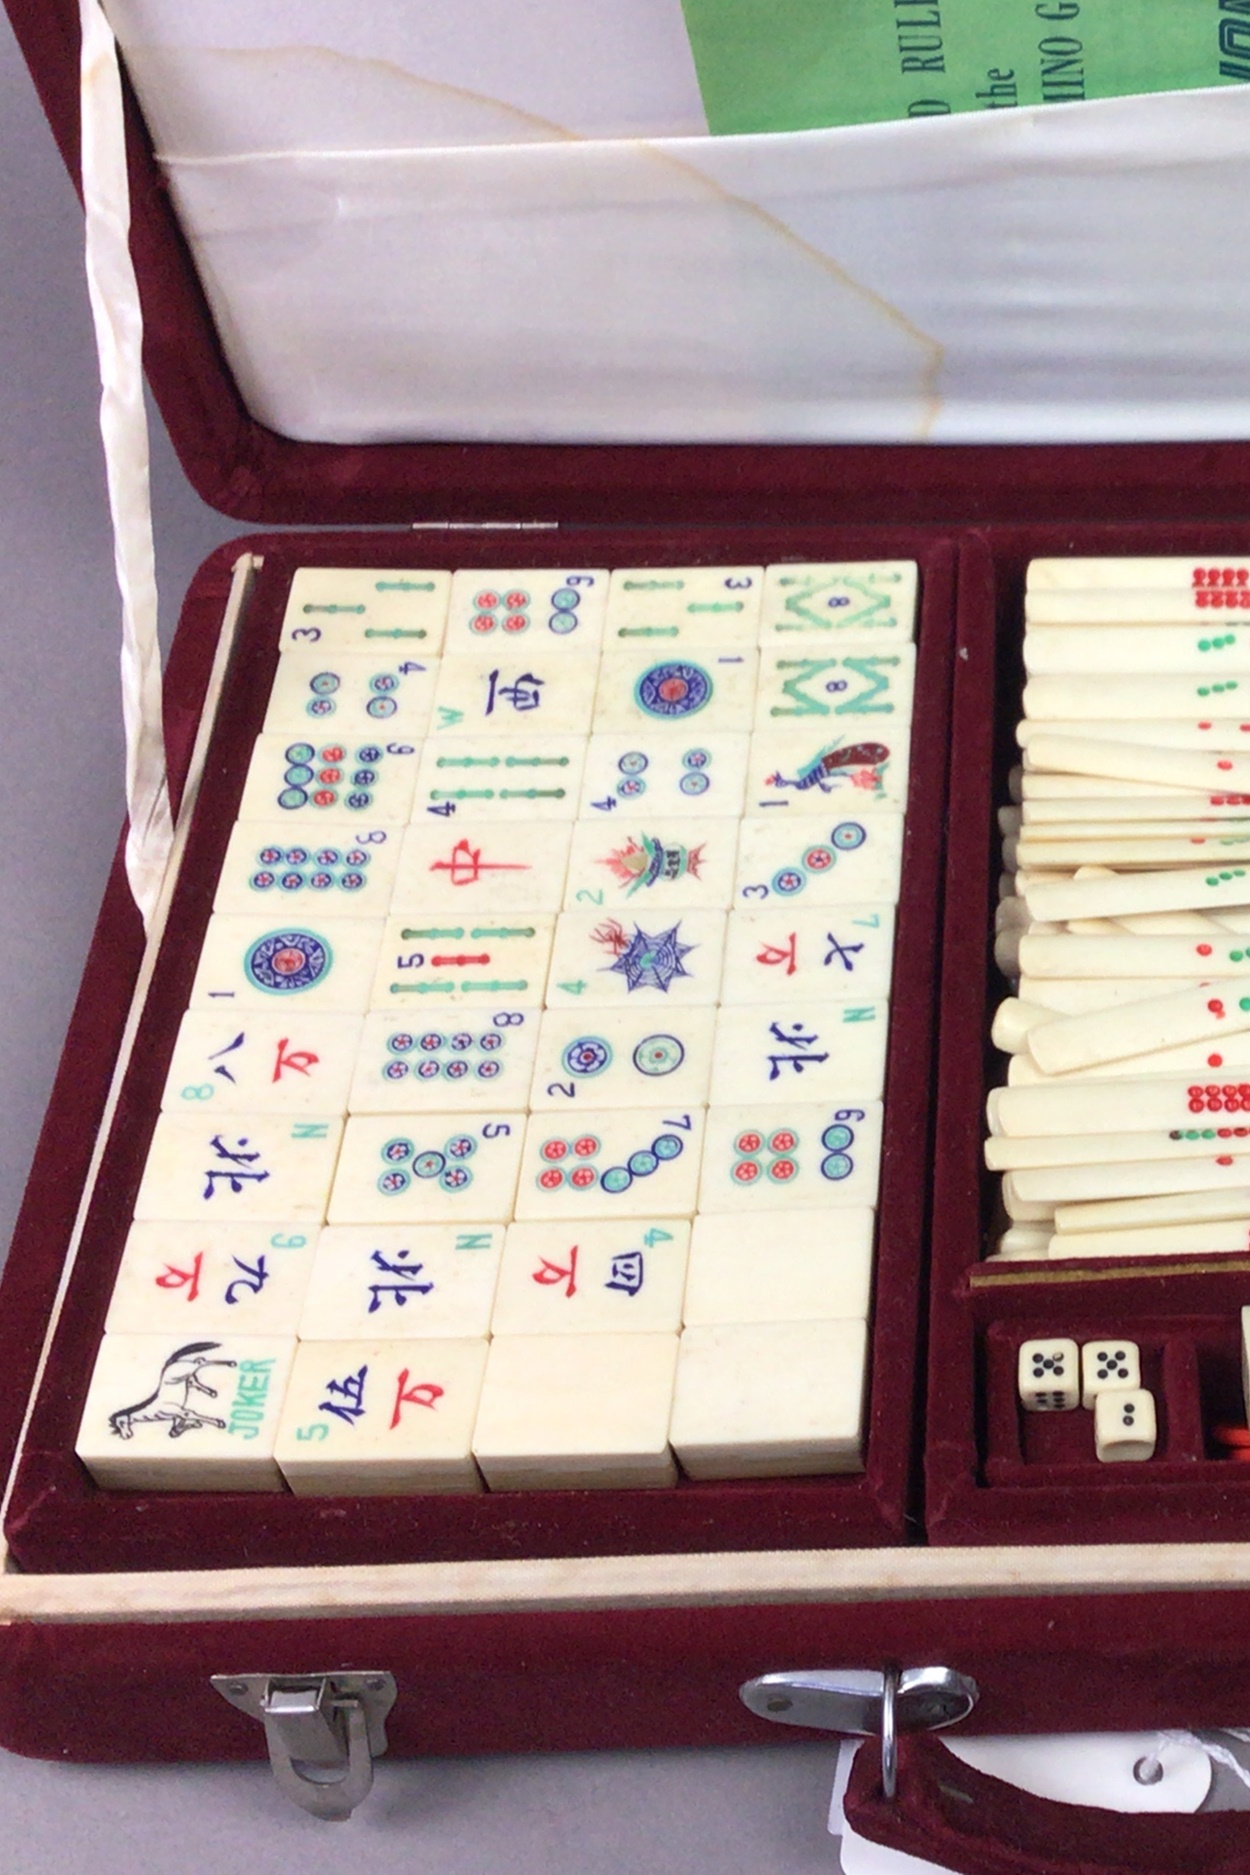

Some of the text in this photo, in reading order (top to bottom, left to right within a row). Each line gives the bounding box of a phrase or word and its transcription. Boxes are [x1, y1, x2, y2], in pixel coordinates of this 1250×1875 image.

[566, 576, 594, 588] 6
[724, 578, 752, 589] 3
[828, 597, 850, 608] 8
[291, 627, 321, 642] 3
[399, 662, 426, 675] 4
[486, 669, 544, 715] 西
[825, 680, 848, 693] 8
[438, 706, 464, 729] W
[427, 801, 456, 817] 4
[591, 796, 617, 811] 4
[759, 800, 789, 808] 1
[430, 839, 527, 886] 中
[576, 890, 603, 905] 2
[742, 885, 770, 899] 3
[853, 914, 880, 928] 7
[397, 953, 424, 969] 5
[557, 979, 587, 995] 4
[493, 1012, 524, 1027] 8
[843, 1007, 876, 1023] N
[767, 1022, 829, 1080] 北
[181, 1083, 214, 1101] 8
[547, 1082, 575, 1098] 2
[663, 1114, 691, 1130] 7
[834, 1109, 865, 1122] 6
[291, 1123, 329, 1139] N
[482, 1123, 510, 1139] 5
[203, 1135, 270, 1200] 北
[455, 1233, 492, 1250] N
[643, 1228, 673, 1248] 4
[368, 1250, 434, 1313] 北
[228, 1358, 275, 1440] JOKER
[296, 1423, 329, 1441] 5
